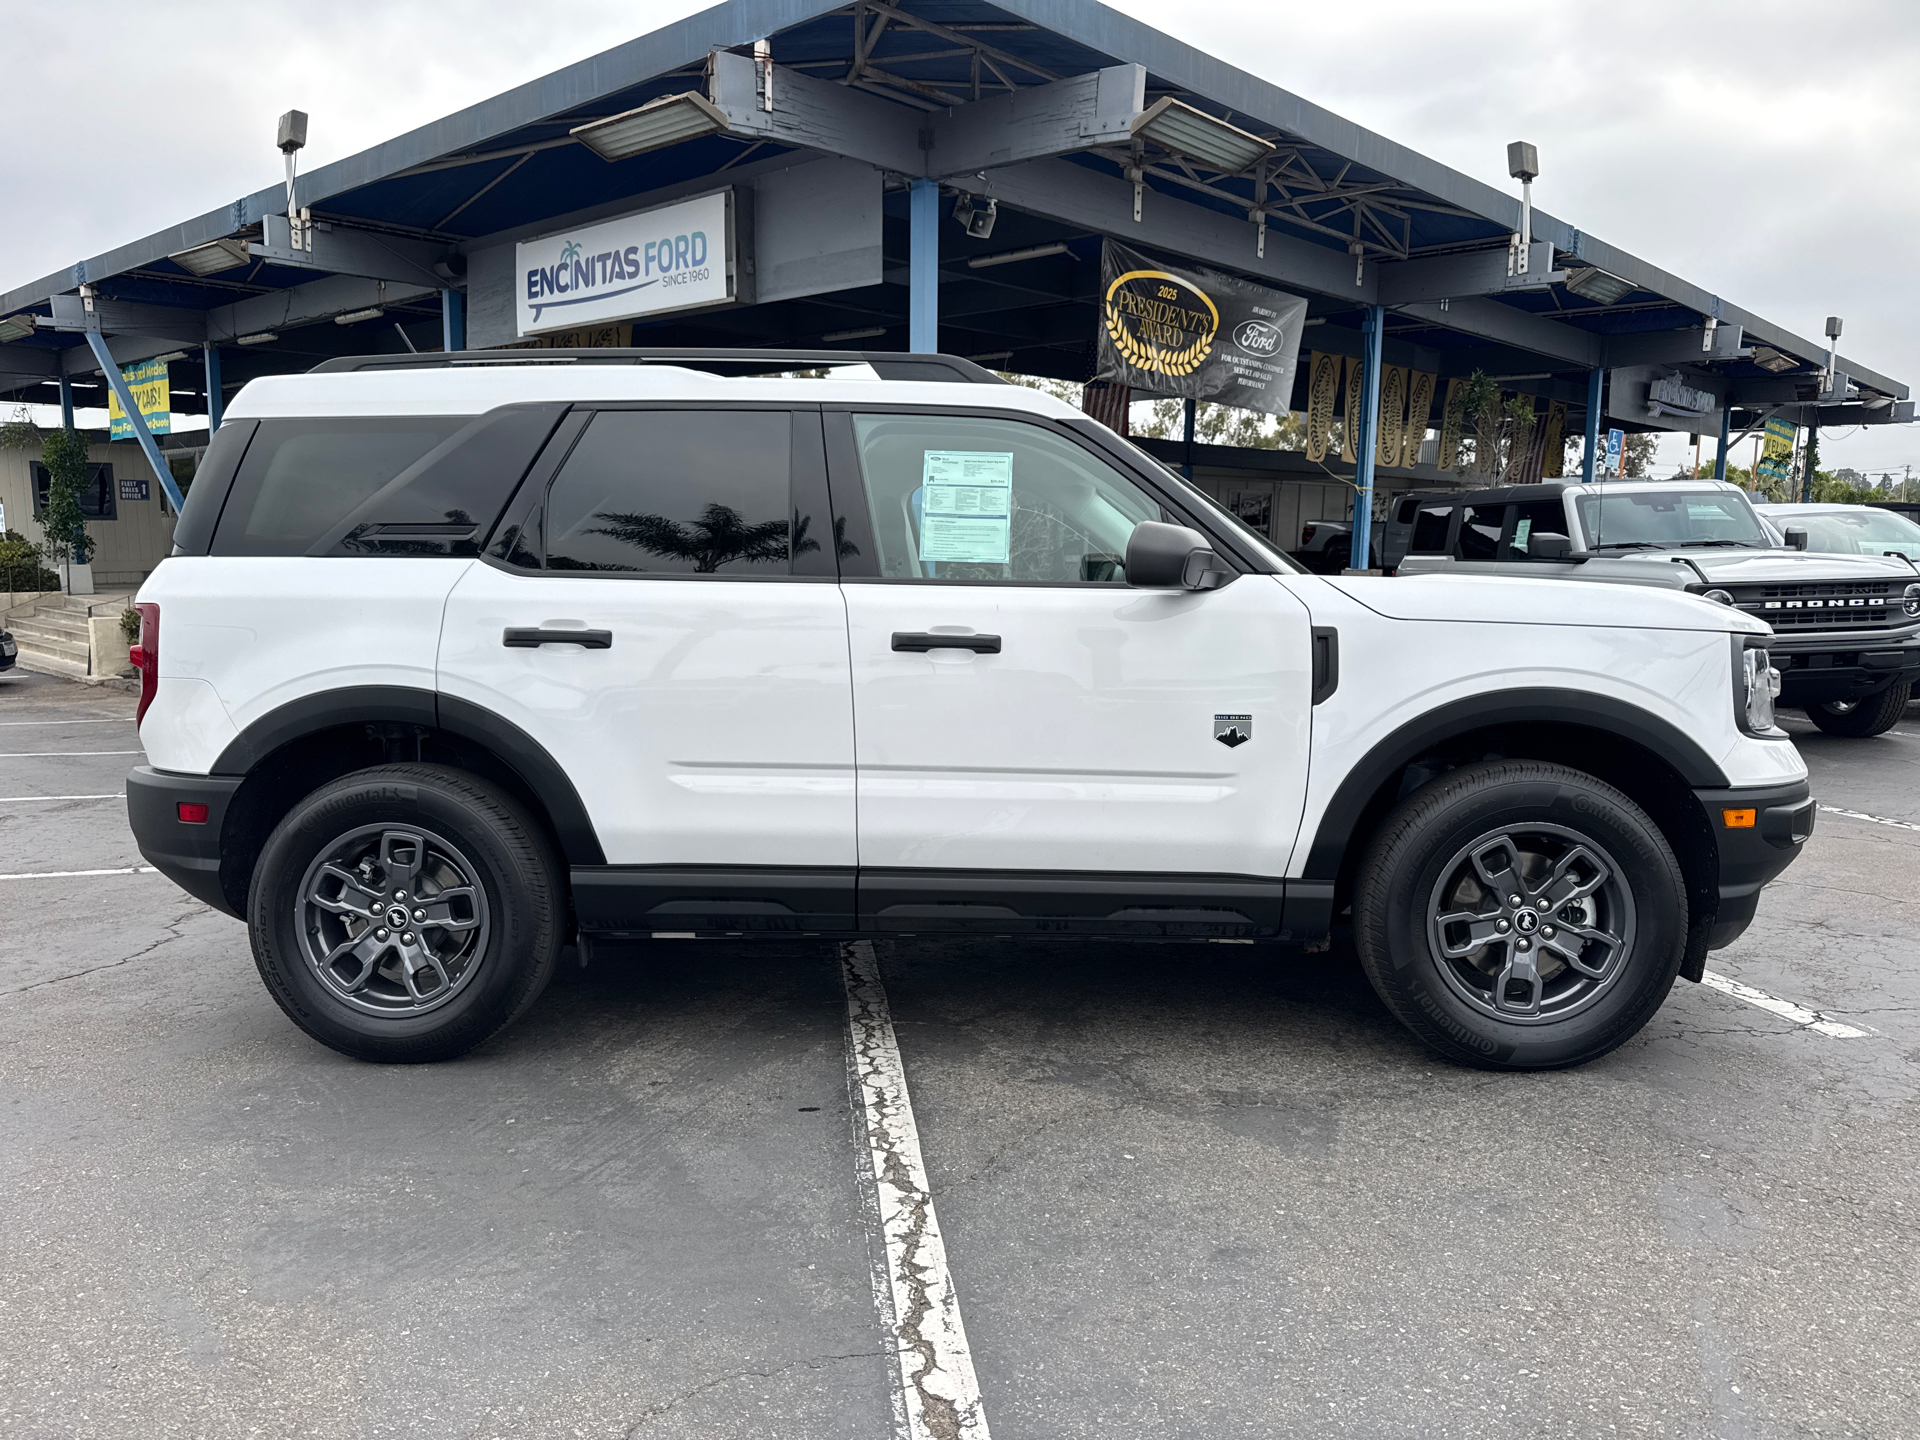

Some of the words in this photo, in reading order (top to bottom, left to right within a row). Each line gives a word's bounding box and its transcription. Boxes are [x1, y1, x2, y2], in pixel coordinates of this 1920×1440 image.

[527, 246, 640, 300] ENCINITAS
[644, 232, 707, 277] FORD
[662, 272, 688, 288] SINCE
[688, 268, 710, 282] 1960
[1157, 286, 1178, 301] 2025
[1118, 290, 1211, 334] PRESIDENT'S
[1136, 318, 1183, 348] AWARD
[1242, 323, 1277, 351] Ford
[146, 362, 167, 378] Models
[1221, 354, 1232, 362] FOR
[112, 425, 122, 434] Stop
[1764, 598, 1884, 608] BRONCO
[296, 788, 387, 834] Continental
[1568, 790, 1656, 860] Continental
[1411, 989, 1499, 1057] Continental
